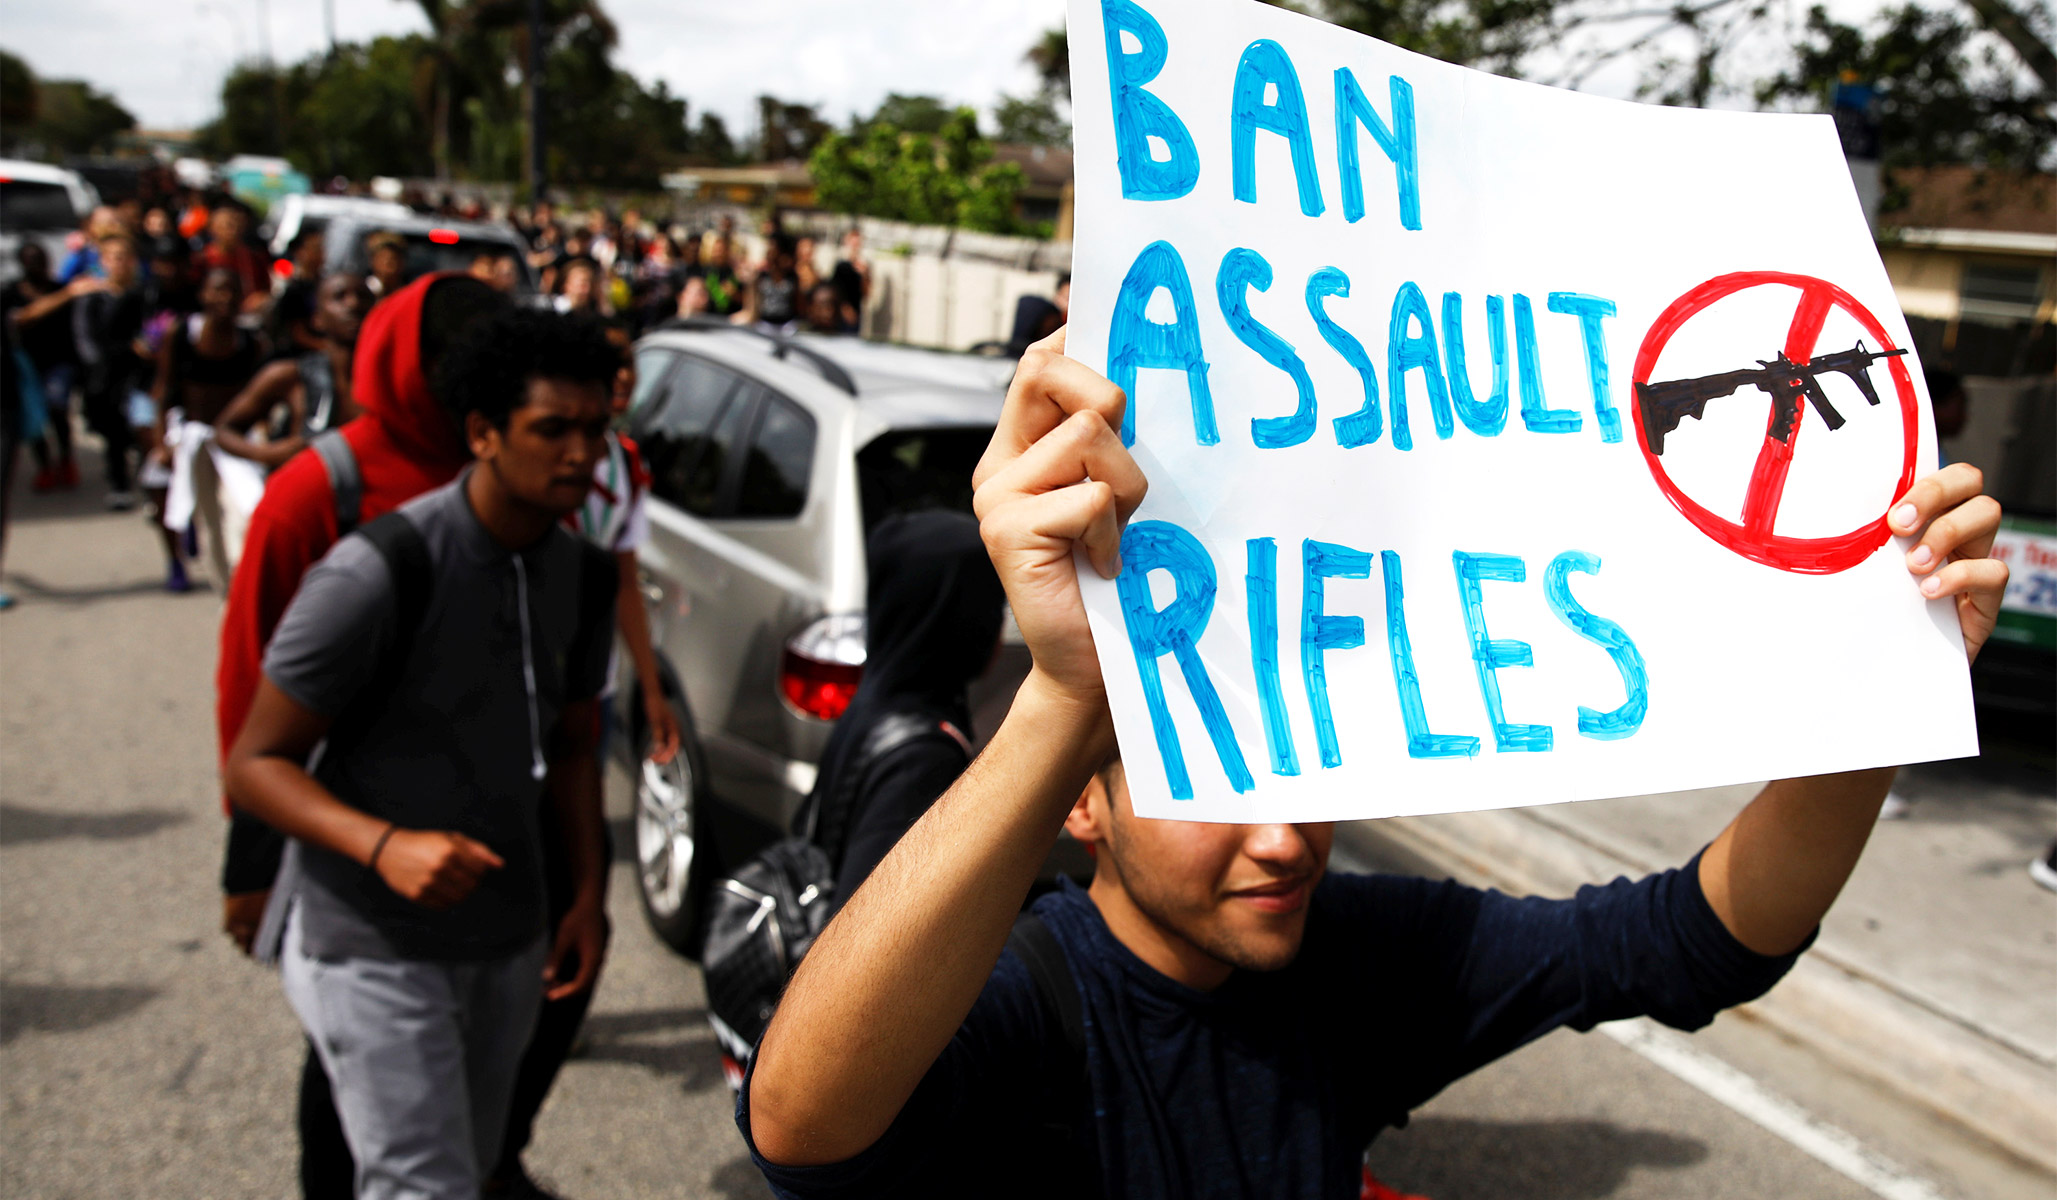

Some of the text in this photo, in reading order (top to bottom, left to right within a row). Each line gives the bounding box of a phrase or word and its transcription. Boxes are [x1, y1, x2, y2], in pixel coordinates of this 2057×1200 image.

[1101, 0, 1422, 231] BAN
[1107, 240, 1623, 451] ASSAULT
[1115, 520, 1649, 800] RIFLES
